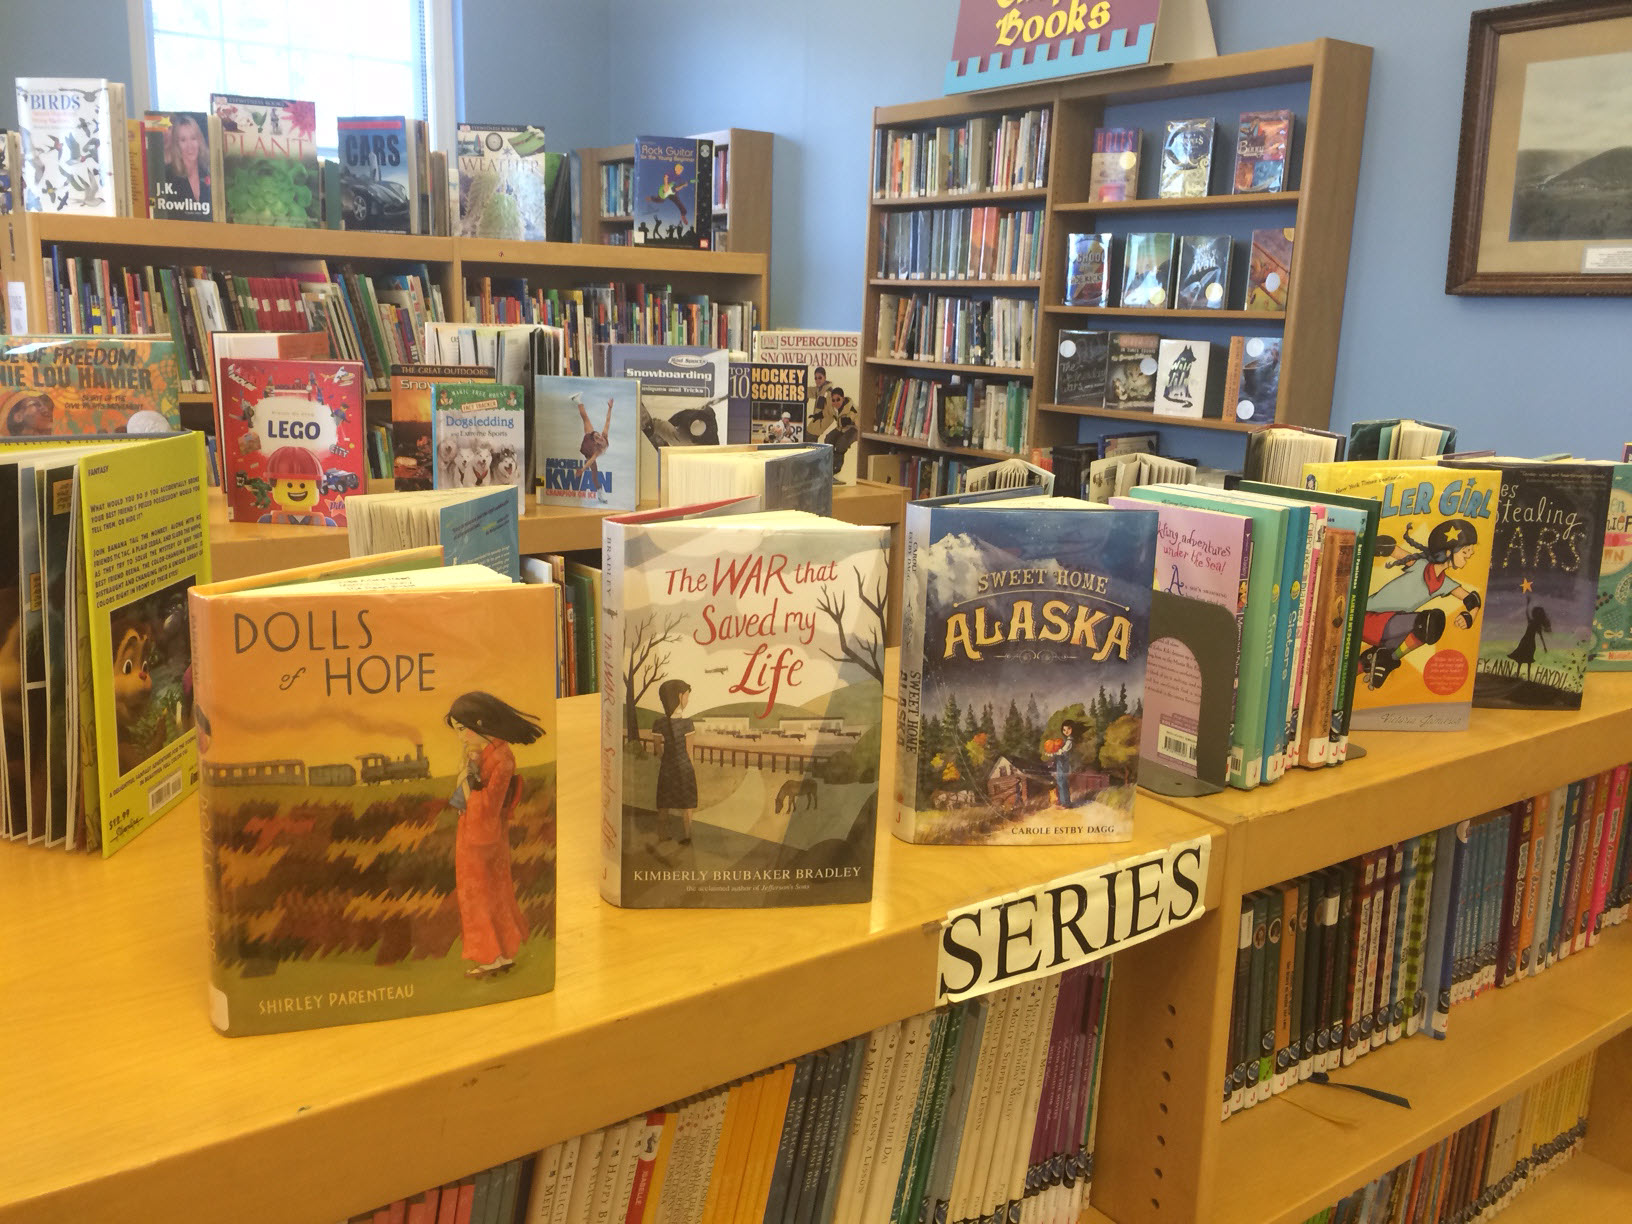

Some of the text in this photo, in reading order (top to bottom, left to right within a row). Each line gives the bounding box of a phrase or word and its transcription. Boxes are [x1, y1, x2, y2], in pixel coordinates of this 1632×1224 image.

[995, 0, 1111, 46] Books
[30, 94, 80, 110] BIRDS
[223, 133, 312, 160] PLANT
[345, 134, 401, 167] CARS
[641, 144, 694, 156] Rock Guitar
[1097, 130, 1134, 153] HOLES
[462, 157, 540, 173] WEATHER
[156, 182, 178, 197] J.K.
[157, 198, 211, 215] Rowling
[780, 336, 858, 348] SUPERGUIDES
[53, 346, 137, 366] FREEDOM
[759, 351, 858, 367] SNOWBOARDING
[32, 366, 152, 390] LOU HAMER
[401, 366, 415, 374] THE
[626, 368, 713, 382] Snowboarding
[728, 367, 750, 376] TOP
[751, 367, 805, 384] HOCKEY
[729, 376, 750, 399] 10
[751, 383, 805, 401] SCORERS
[267, 419, 321, 440] LEGO
[445, 415, 515, 429] Dogsledding
[88, 465, 109, 476] FANTASY
[545, 468, 613, 494] KWAN
[107, 498, 123, 508] WOULD
[125, 495, 135, 503] YOU
[150, 488, 159, 496] YOU
[1438, 477, 1493, 519] GIRL
[1164, 542, 1189, 559] under
[1191, 550, 1204, 568] the
[1181, 529, 1232, 557] adventures
[603, 537, 613, 597] BRADLEY
[665, 553, 839, 600] The WAR that
[978, 568, 1109, 595] SWEET HOME
[233, 608, 373, 655] DOLLS
[693, 598, 817, 646] Saved my
[943, 599, 1134, 662] ALASKA
[1281, 609, 1298, 681] Sisters
[279, 652, 436, 697] of HOPE
[728, 642, 805, 720] Life
[1492, 660, 1514, 678] ANN
[906, 670, 921, 753] SWEET HOME
[1011, 825, 1115, 836] CAROLE ESTBY DAGG
[633, 865, 862, 882] KIMBERLY BRUBAKER BRADLEY
[697, 884, 730, 892] acclaimed
[940, 844, 1202, 996] SERIES
[258, 983, 415, 1016] SHIRLEY PARENTEAU
[897, 1051, 914, 1092] KIRSTEN
[852, 1060, 875, 1137] MEET KIRSTEN
[857, 1056, 893, 1194] KIRSTEN LEARNS LESSON
[600, 1163, 618, 1207] HAPPY
[541, 1183, 556, 1218] MEET
